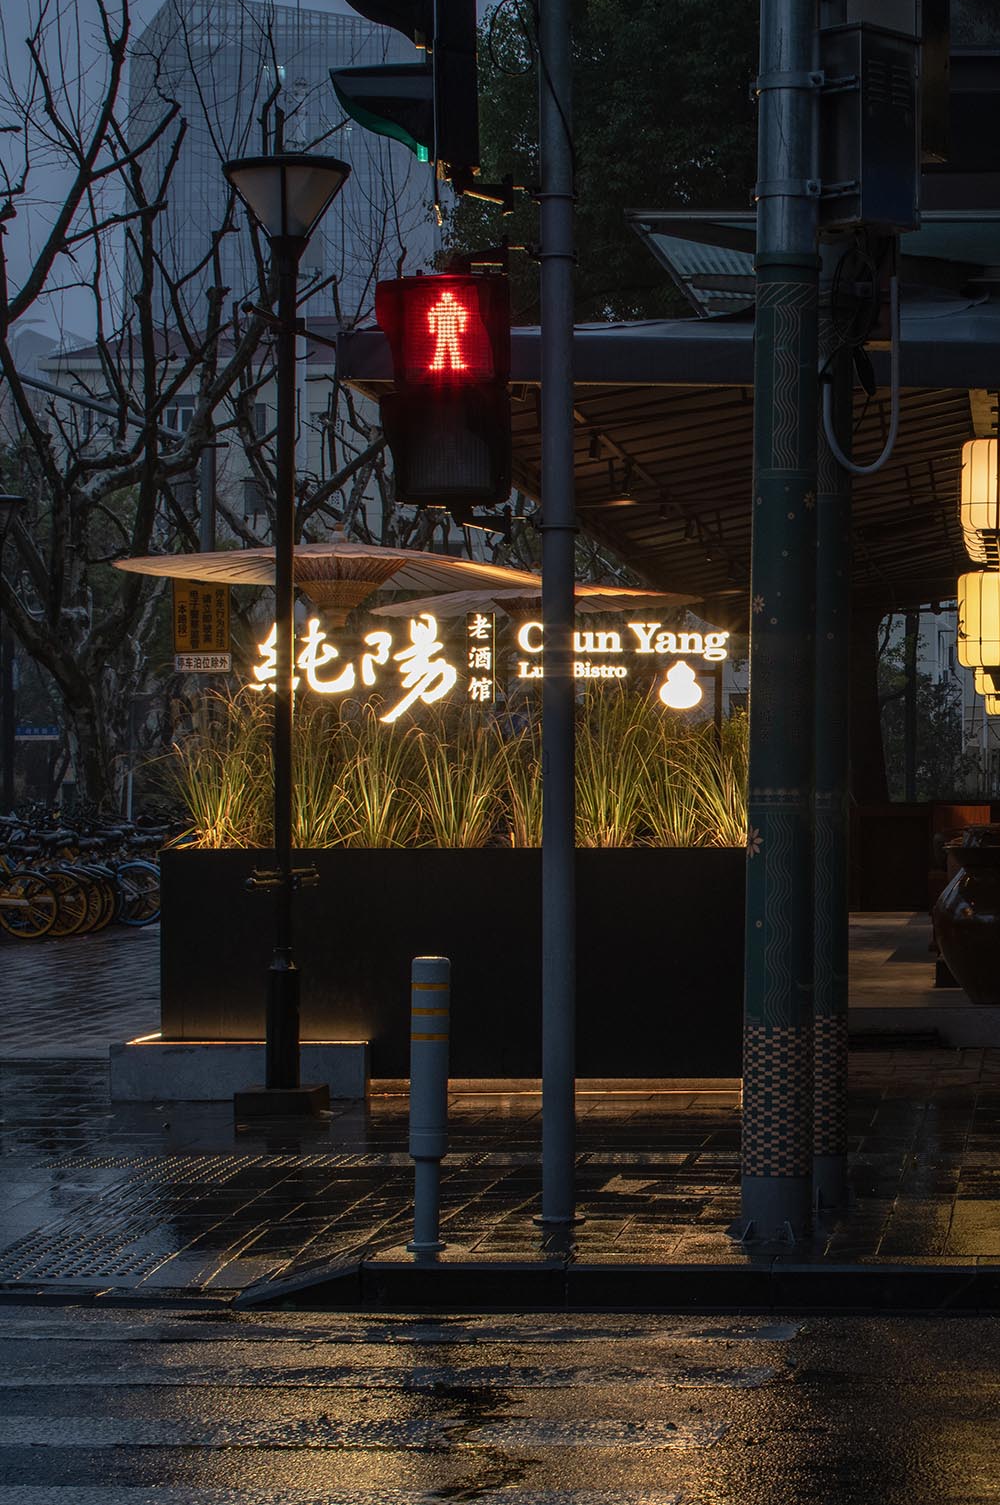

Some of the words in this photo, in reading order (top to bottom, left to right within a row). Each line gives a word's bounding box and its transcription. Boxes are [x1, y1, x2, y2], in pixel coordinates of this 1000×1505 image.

[517, 621, 623, 654] Cun
[627, 622, 731, 661] Yang
[178, 656, 229, 669] 停车泊位除外
[468, 613, 493, 703] 老酒馆
[573, 661, 628, 679] Bistro
